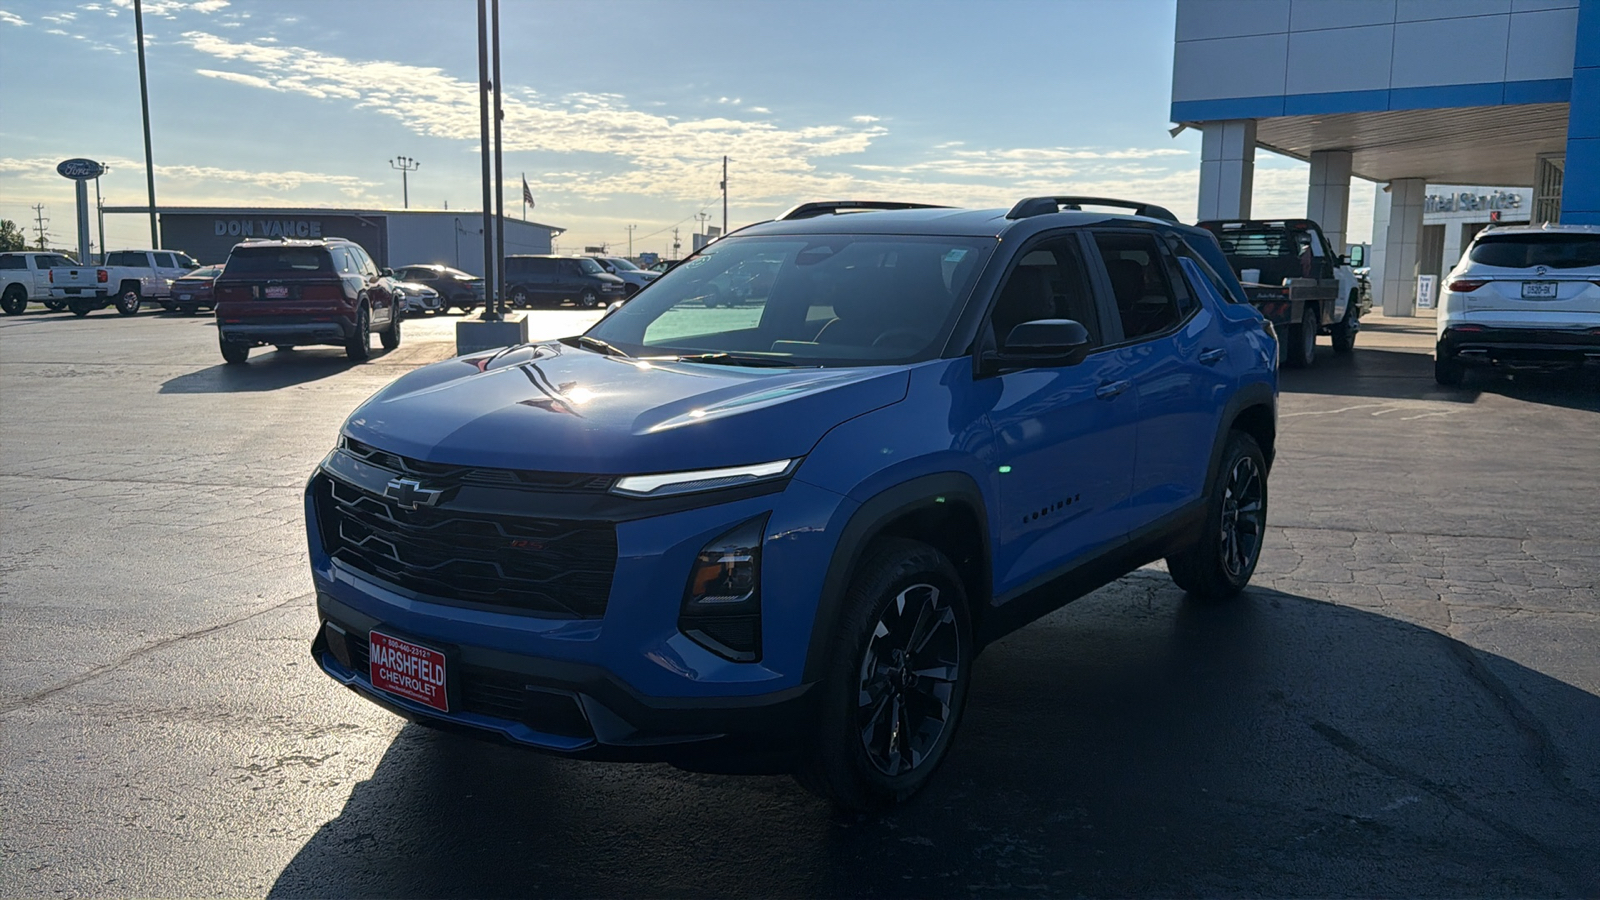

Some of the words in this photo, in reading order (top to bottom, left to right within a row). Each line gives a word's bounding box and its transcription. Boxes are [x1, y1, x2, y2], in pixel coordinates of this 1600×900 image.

[65, 161, 89, 175] Ford
[215, 220, 253, 236] DON
[261, 221, 321, 237] VANCE
[388, 639, 427, 658] 800-440-2312
[371, 642, 444, 687] MARSHFIELD
[379, 668, 437, 697] CHEVROLET
